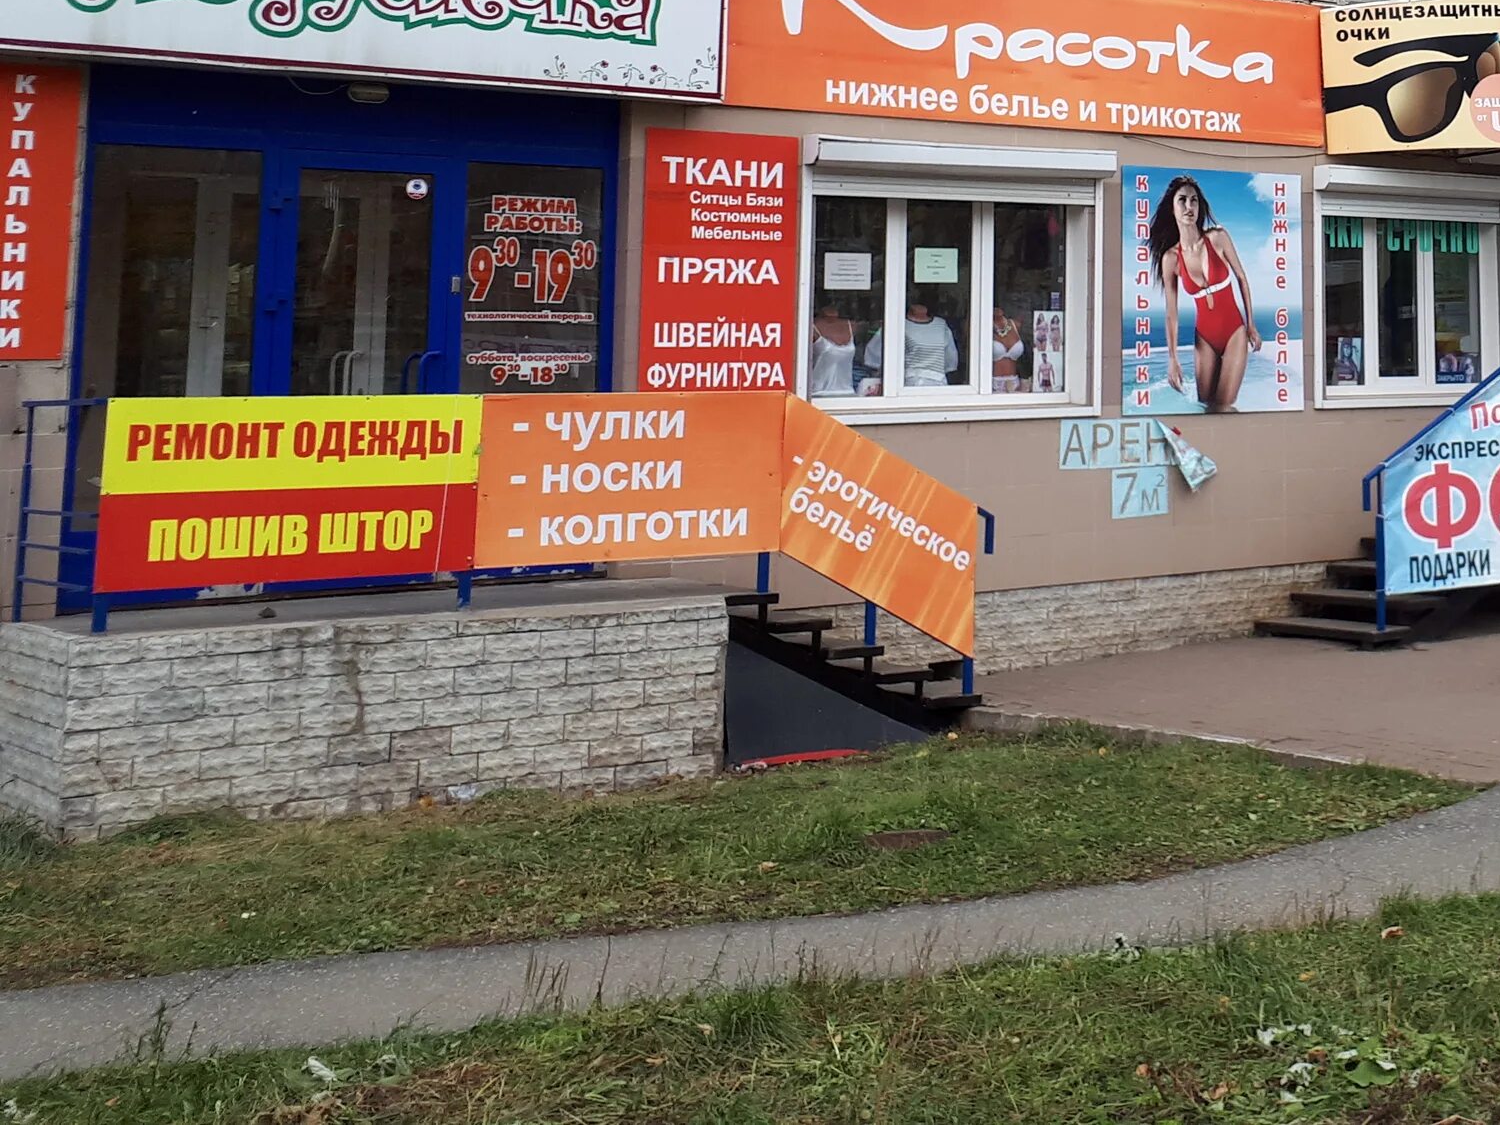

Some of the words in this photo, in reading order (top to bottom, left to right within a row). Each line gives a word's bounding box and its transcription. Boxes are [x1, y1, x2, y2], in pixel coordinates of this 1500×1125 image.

[1336, 27, 1390, 42] ОЧКИ
[826, 80, 957, 112] нижнее
[969, 87, 1069, 121] белье
[1081, 102, 1098, 123] и
[1107, 101, 1241, 135] трикотаж
[662, 156, 783, 188] ТКАНИ
[0, 74, 37, 349] КУПАЛЬНИКИ
[492, 195, 577, 215] РЕЖИМ
[690, 191, 742, 206] Ситцы
[746, 192, 783, 207] Бязи
[484, 214, 583, 235] РАБОТЫ:
[691, 209, 782, 223] Костюмные
[692, 226, 782, 241] Мебельные
[1387, 219, 1480, 254] СРОЧНО
[658, 257, 779, 285] ПРЯЖА
[465, 311, 549, 321] технологический
[551, 313, 594, 323] перерыв
[654, 316, 781, 347] ШВЕЙНАЯ
[467, 352, 518, 364] суббота,
[520, 353, 592, 363] воскресенье
[647, 362, 785, 388] ФУРНИТУРА
[126, 421, 285, 462] РЕМОНТ
[293, 419, 463, 462] ОДЕЖДЫ
[789, 486, 877, 552] бельё
[807, 461, 970, 571] эротическое
[148, 511, 309, 563] ПОШИВ
[318, 508, 434, 555] ШТОР
[1410, 549, 1491, 586] ПОДАРКИ
